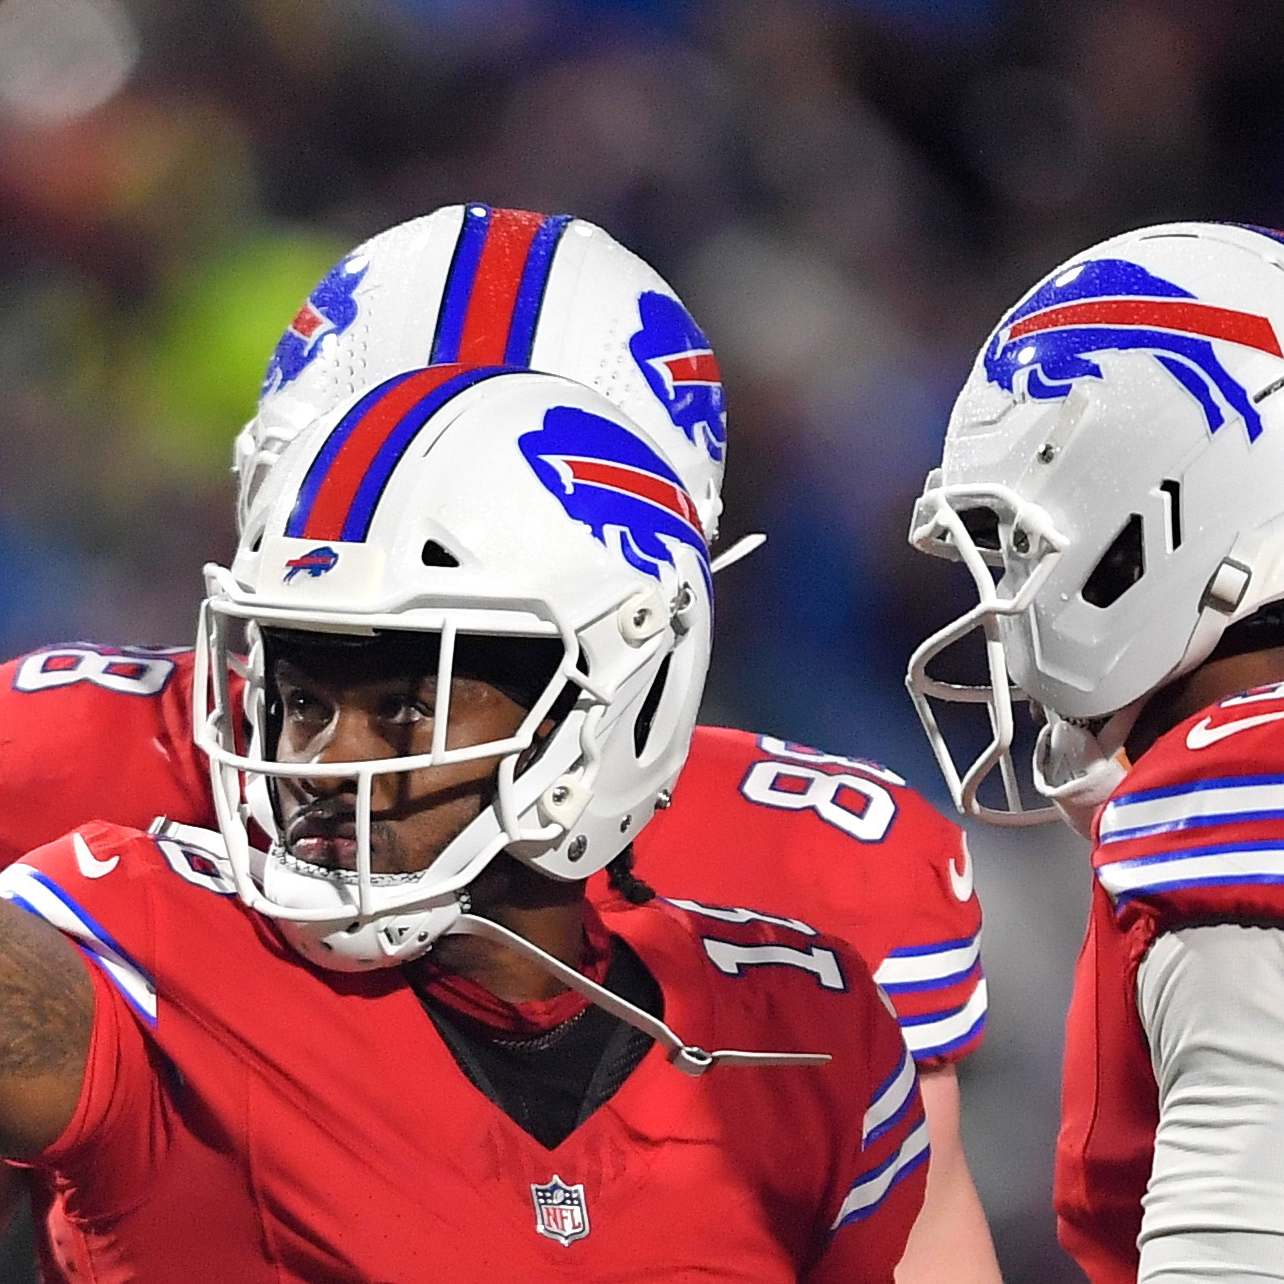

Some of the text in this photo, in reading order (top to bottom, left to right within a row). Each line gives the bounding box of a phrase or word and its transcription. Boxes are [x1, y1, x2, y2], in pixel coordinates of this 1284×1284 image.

[12, 639, 195, 696] 8
[657, 895, 850, 993] 1
[544, 1207, 582, 1231] NFL
